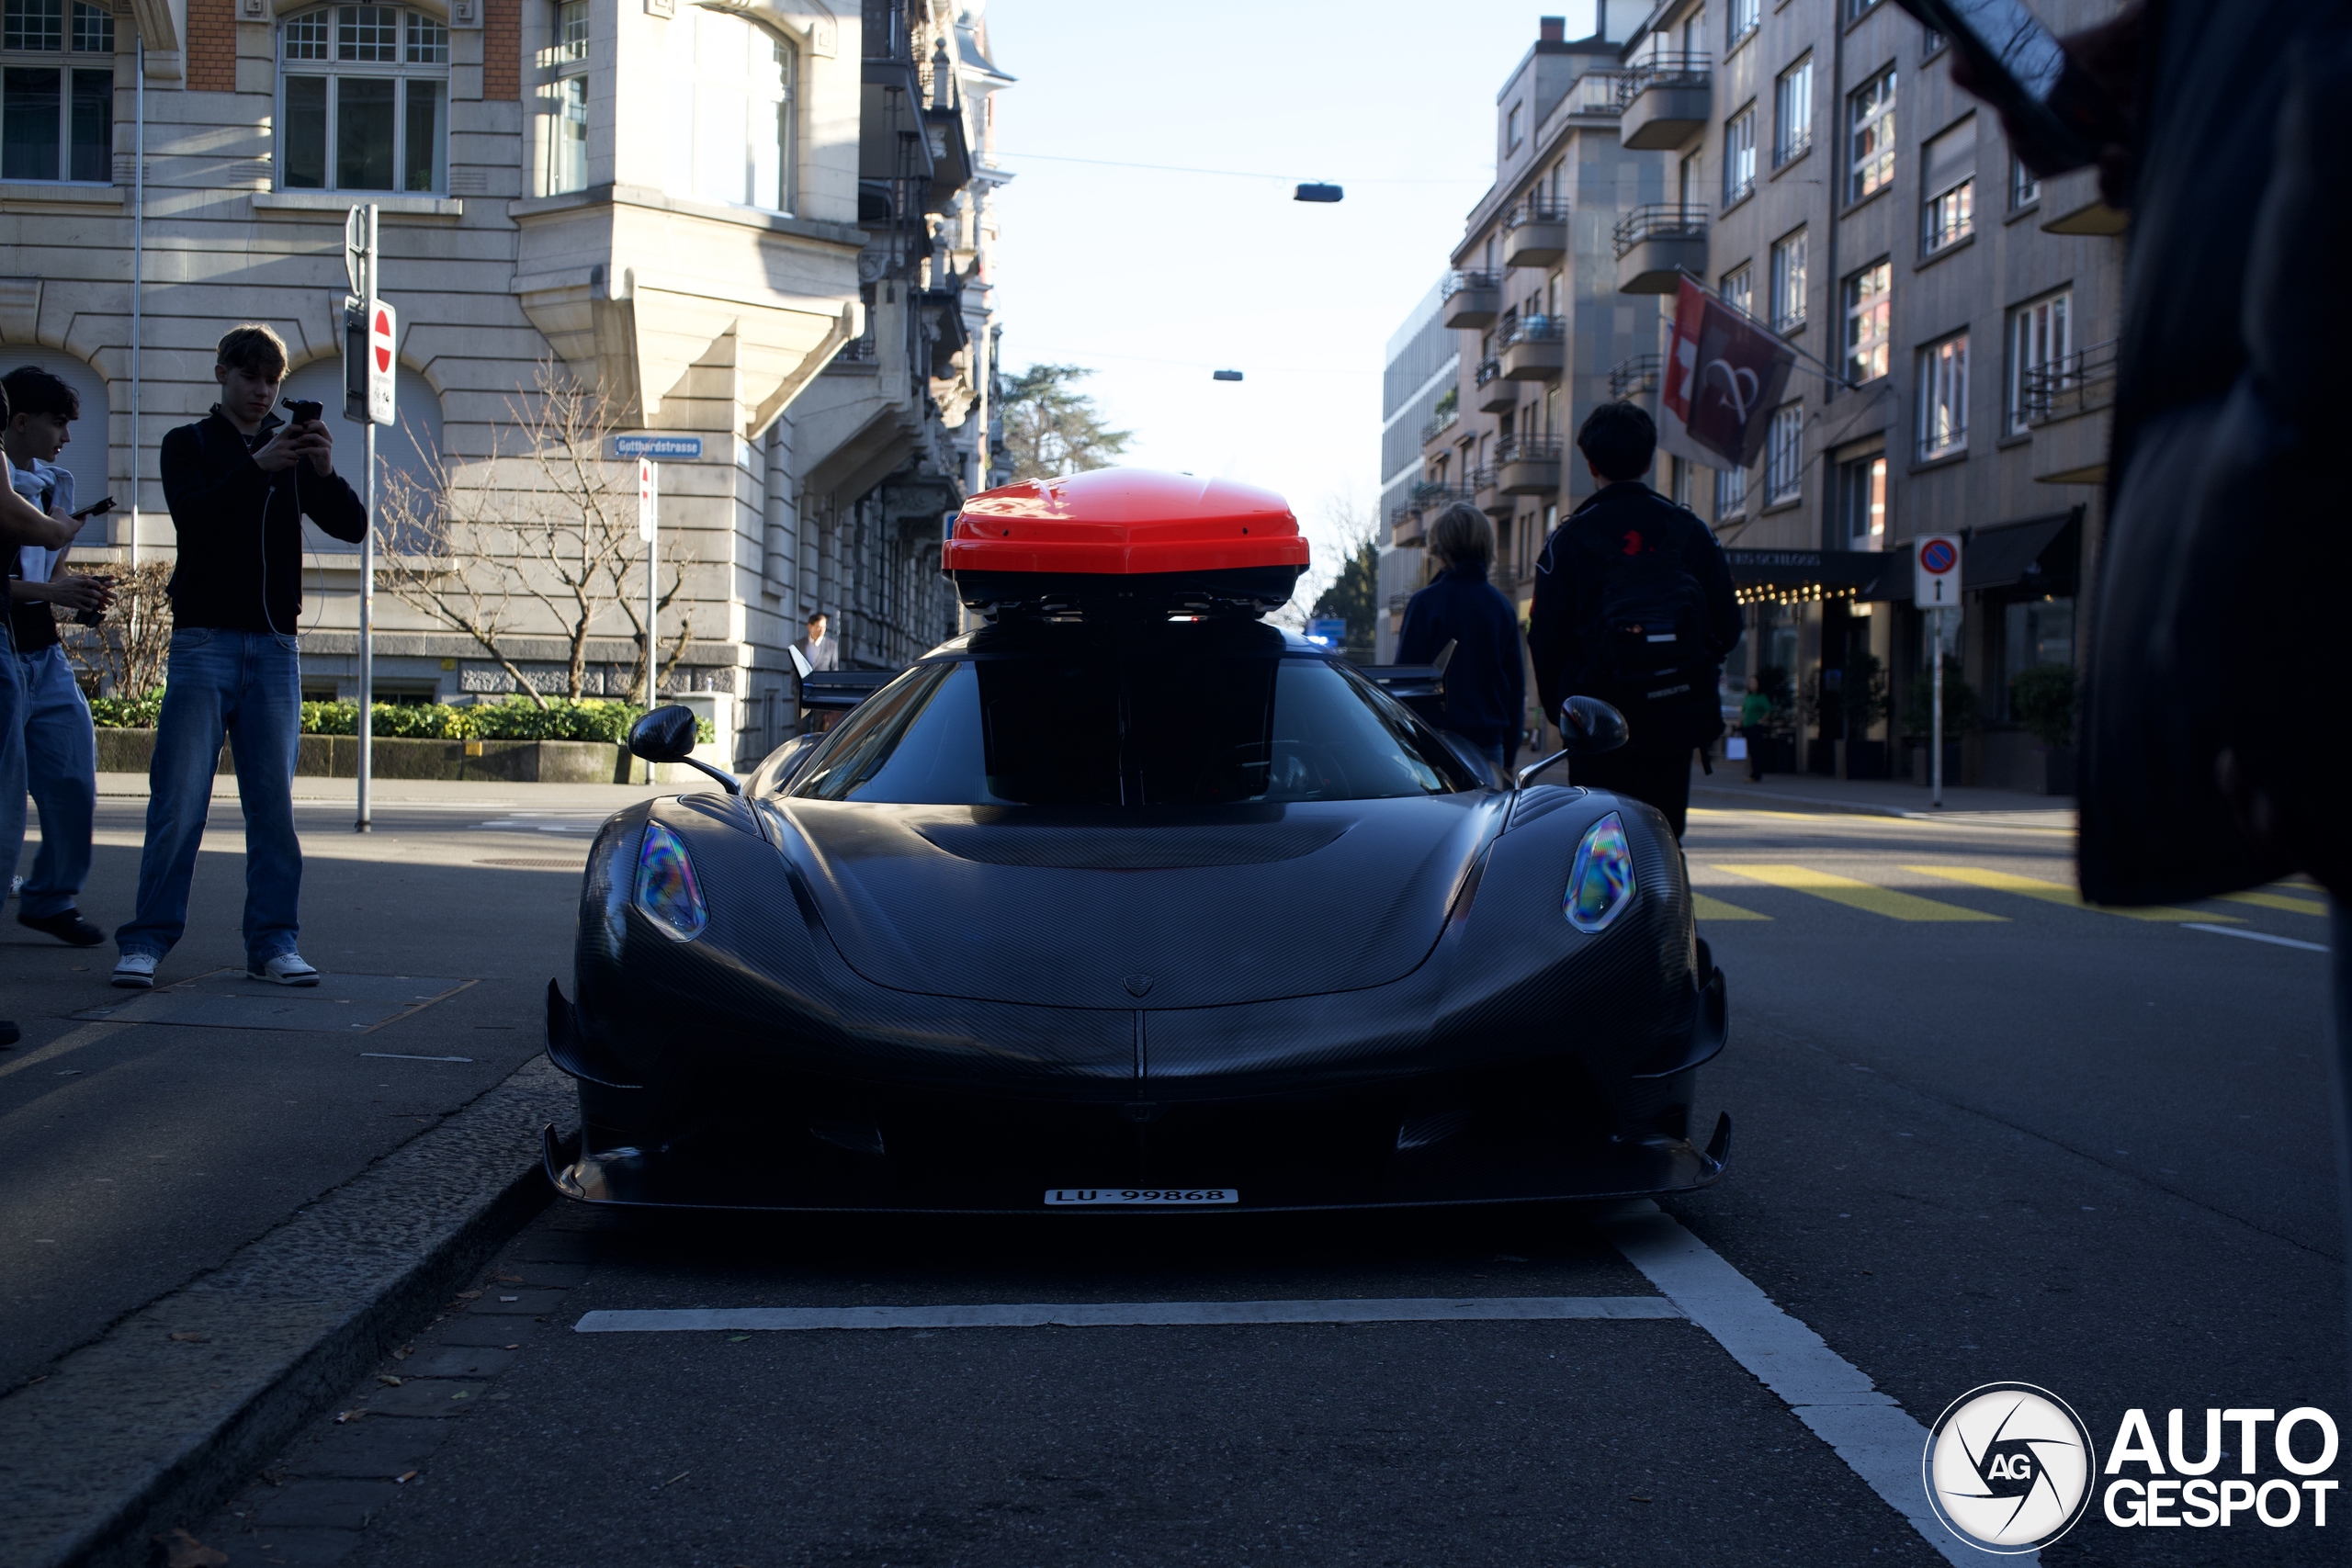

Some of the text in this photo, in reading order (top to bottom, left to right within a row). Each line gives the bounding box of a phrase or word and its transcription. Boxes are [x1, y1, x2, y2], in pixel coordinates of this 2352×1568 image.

[619, 439, 698, 453] Gotthardstrasse
[1056, 1190, 1097, 1201] LU
[1121, 1190, 1225, 1201] 99868
